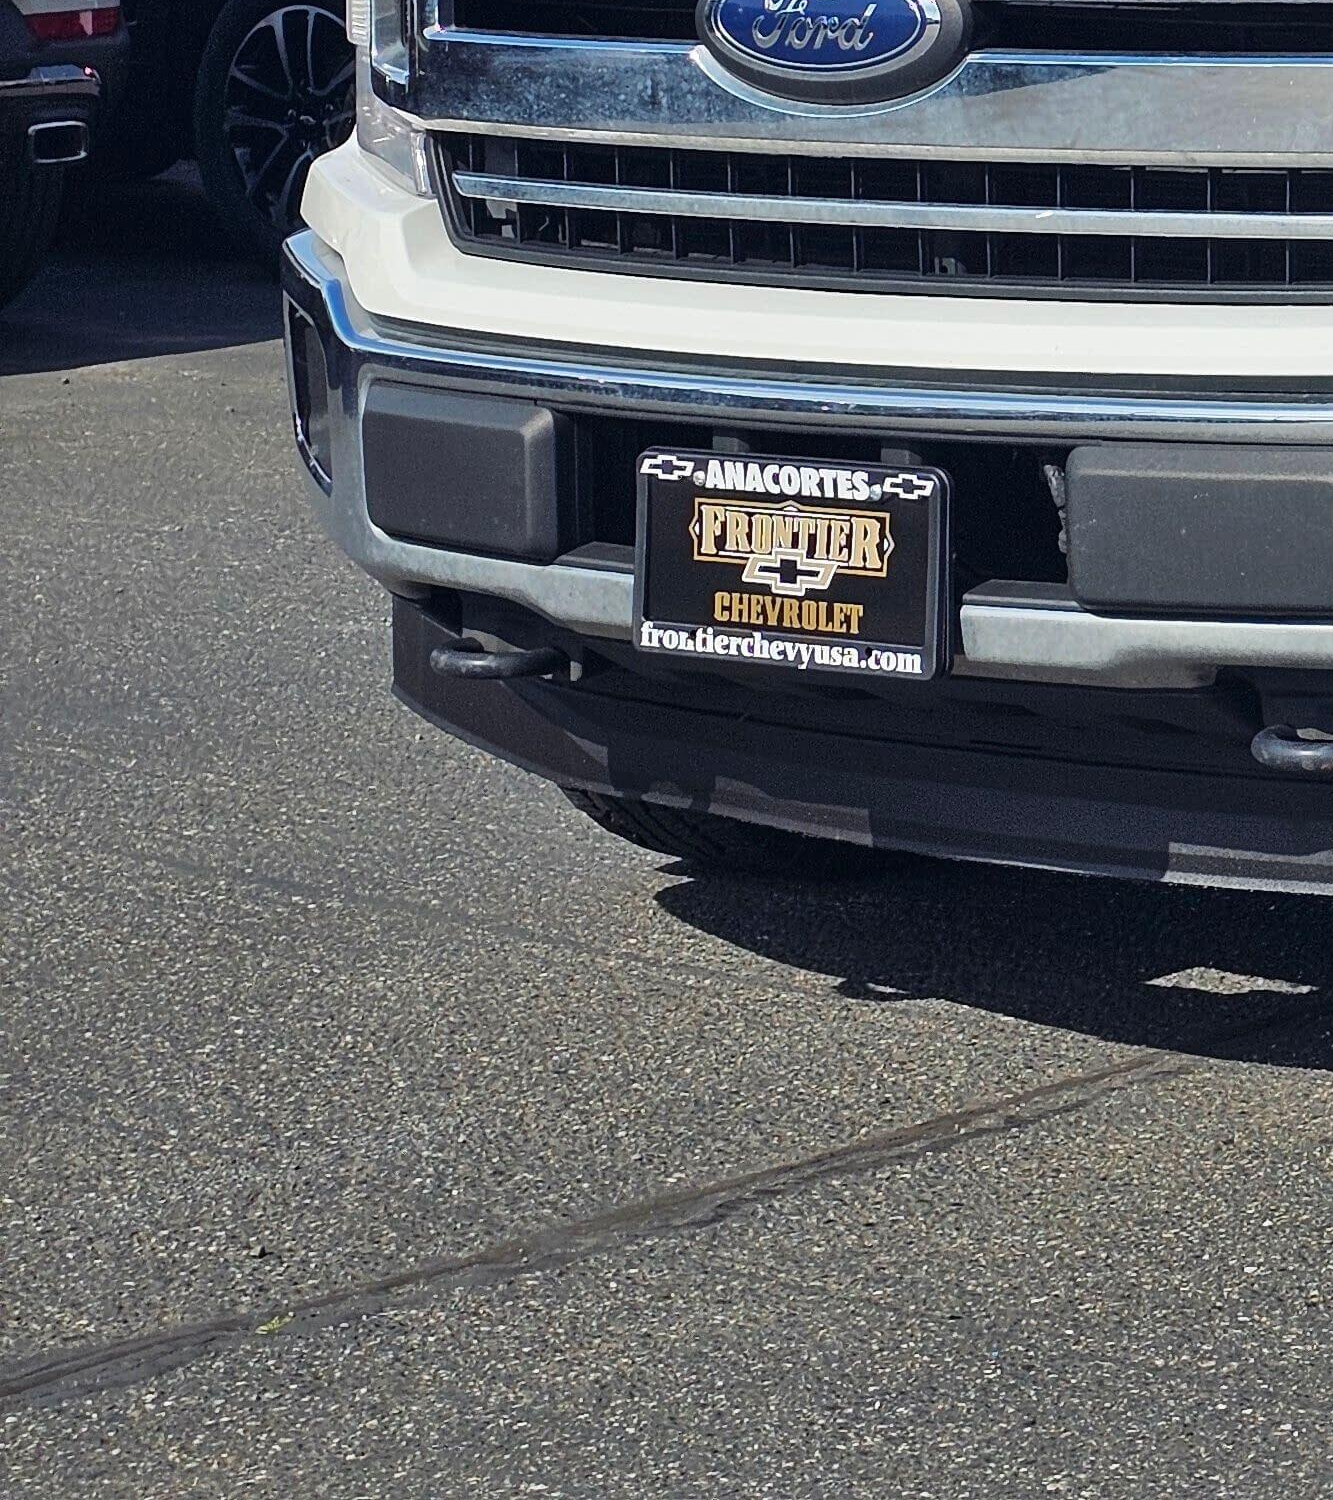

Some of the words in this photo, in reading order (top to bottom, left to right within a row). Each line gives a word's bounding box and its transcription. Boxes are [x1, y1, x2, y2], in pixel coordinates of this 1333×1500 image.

[704, 458, 870, 501] ANACORTES
[699, 503, 883, 570] FRONTIER
[712, 590, 865, 635] CHEVROLET
[639, 621, 923, 675] frontierchevyusa.com
